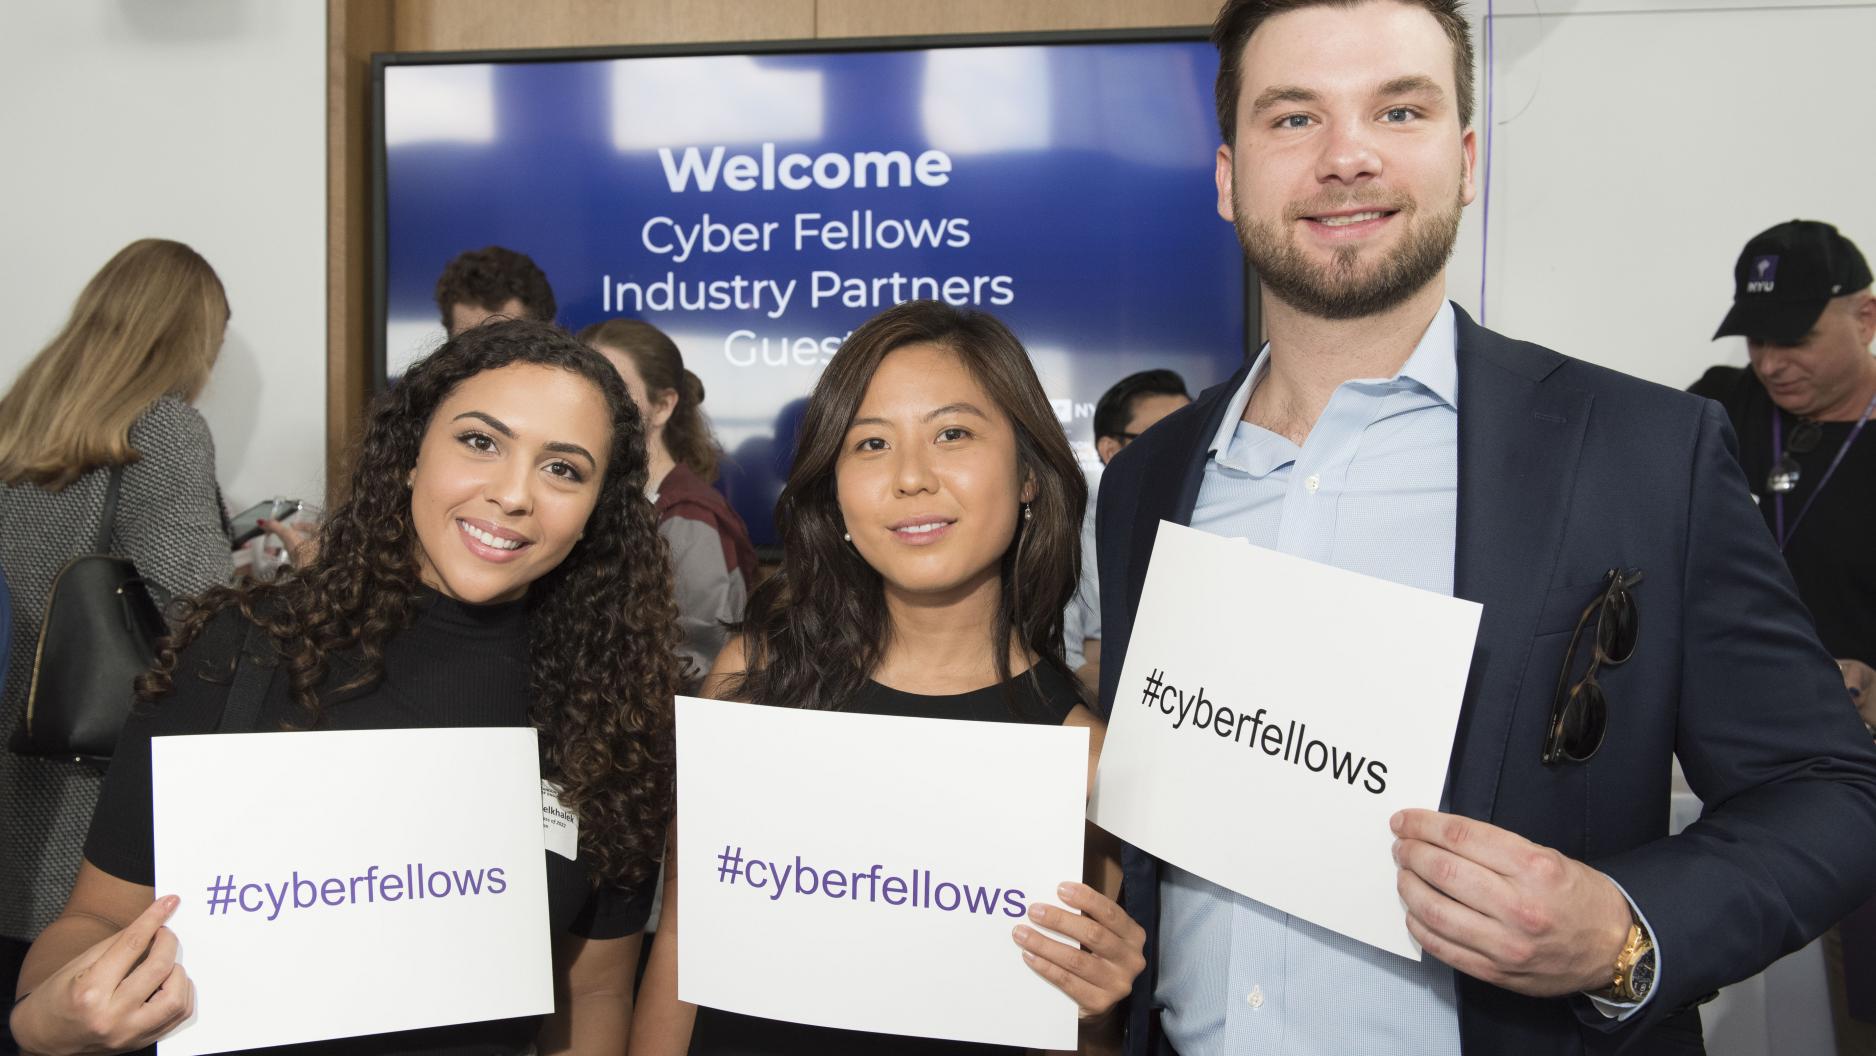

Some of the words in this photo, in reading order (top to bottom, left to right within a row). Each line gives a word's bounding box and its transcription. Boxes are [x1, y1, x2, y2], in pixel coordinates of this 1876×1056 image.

[658, 143, 952, 193] Welcome
[641, 214, 779, 263] Cyber
[794, 210, 971, 251] Fellows
[602, 272, 797, 319] Industry
[811, 270, 1014, 309] Partners
[1747, 281, 1775, 293] NYU
[1141, 668, 1389, 795] #cyberfellows
[206, 863, 507, 921] #cyberfellows
[717, 845, 1027, 918] #cyberfellows
